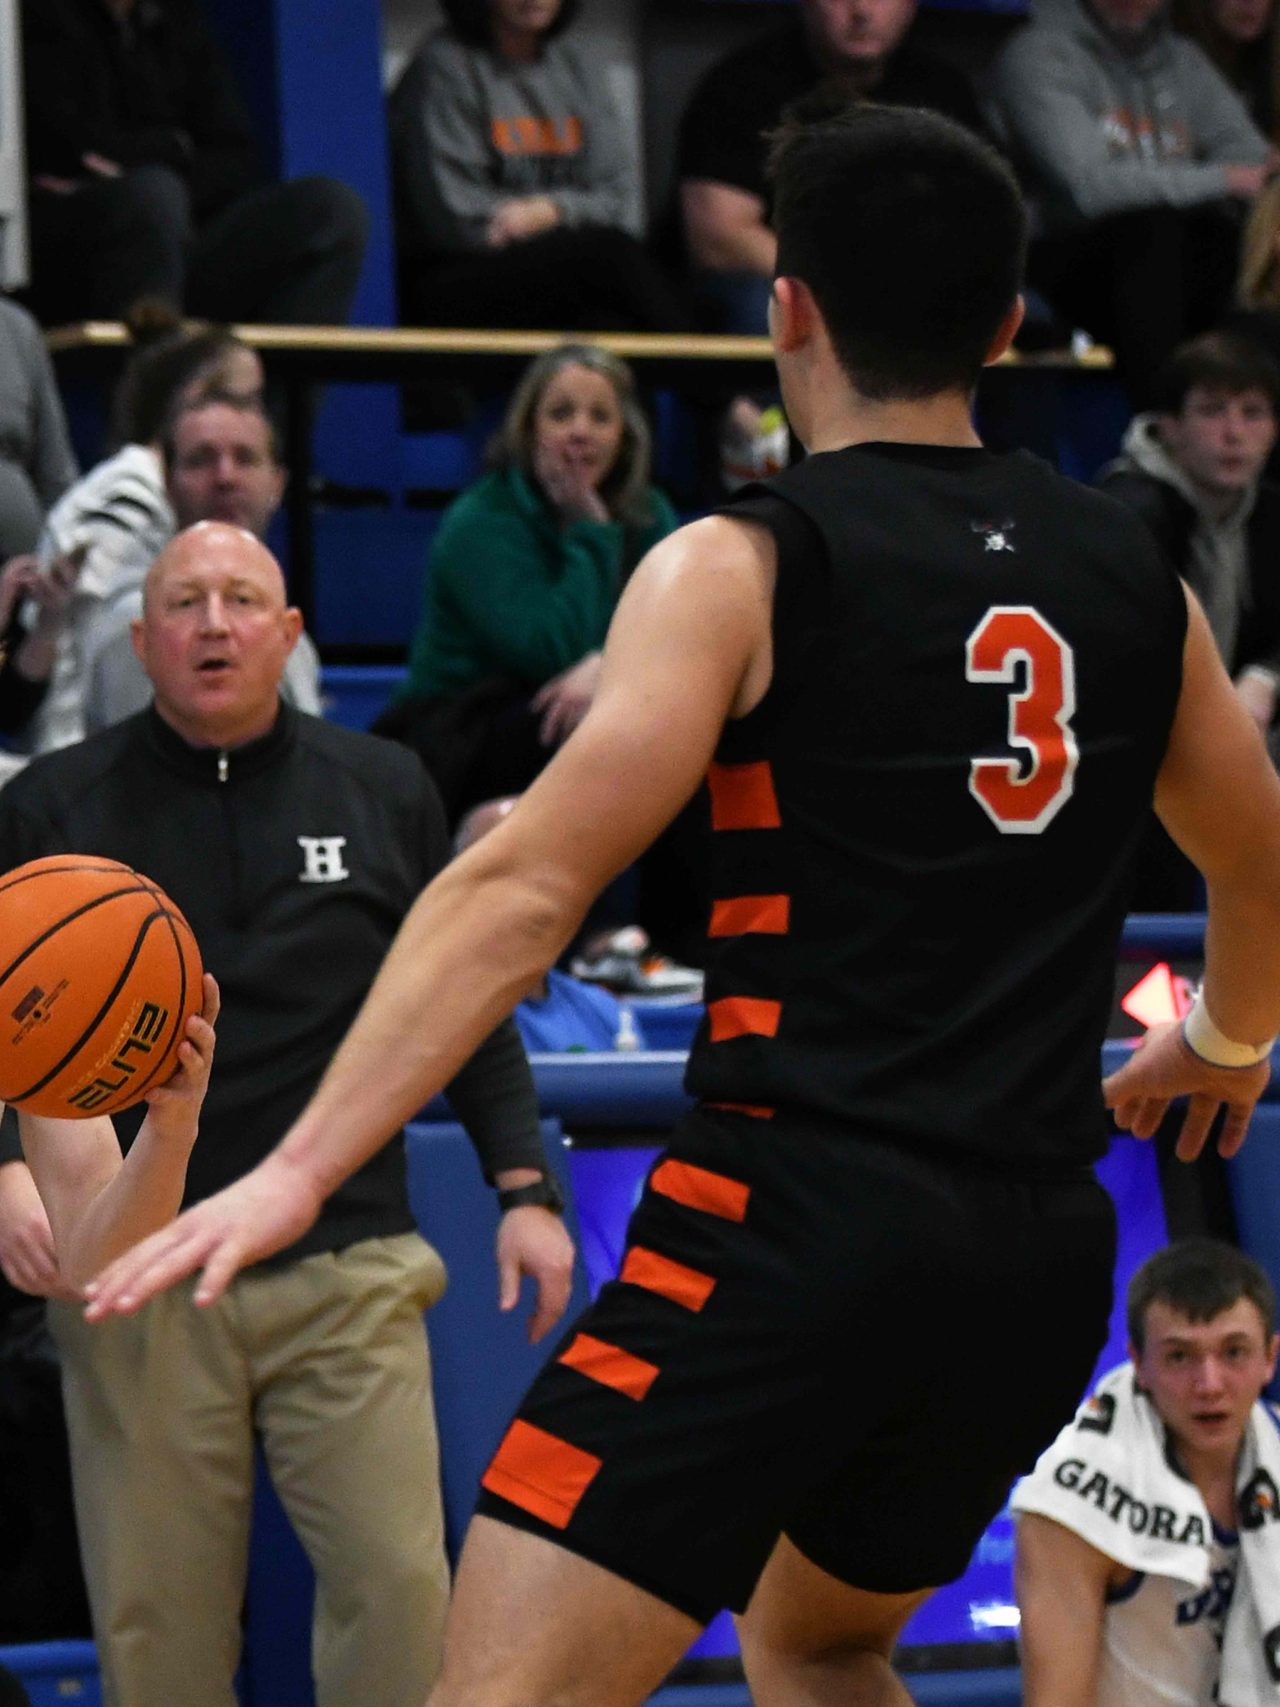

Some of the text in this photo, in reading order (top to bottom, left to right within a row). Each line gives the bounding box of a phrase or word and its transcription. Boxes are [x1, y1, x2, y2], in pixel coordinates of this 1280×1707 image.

[966, 606, 1078, 834] 3
[298, 836, 349, 883] H
[66, 1001, 169, 1111] ELITE
